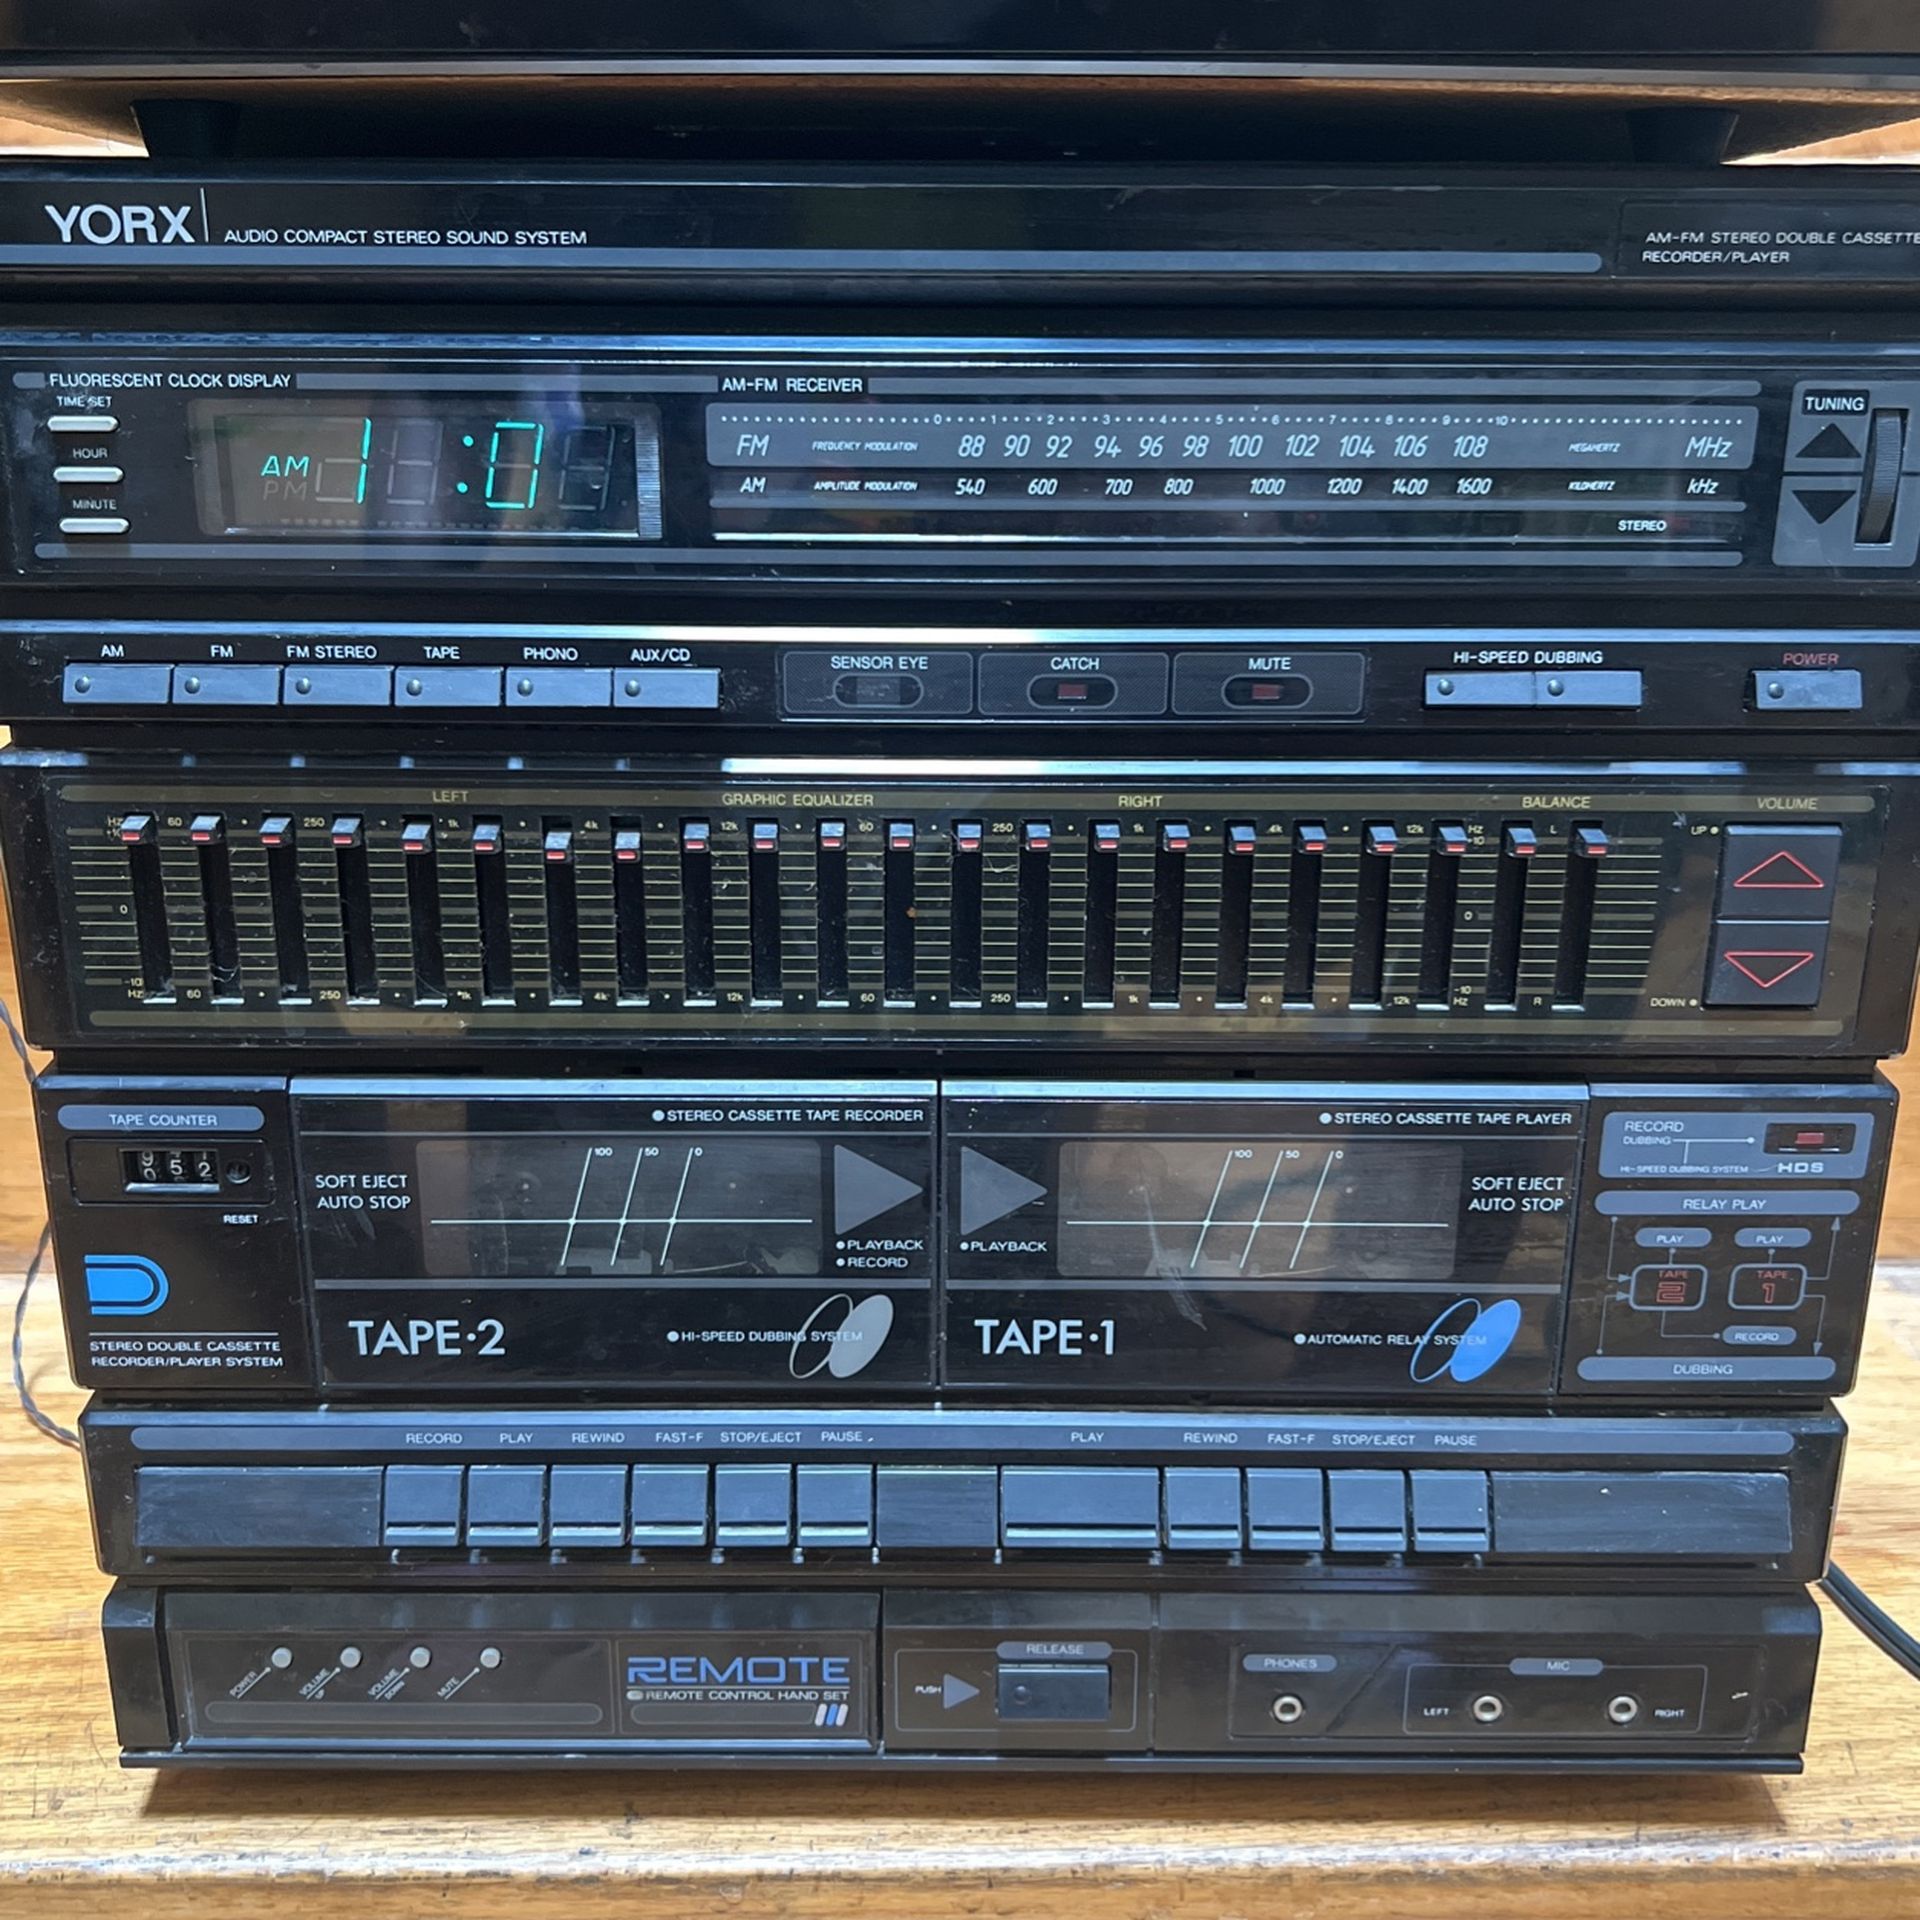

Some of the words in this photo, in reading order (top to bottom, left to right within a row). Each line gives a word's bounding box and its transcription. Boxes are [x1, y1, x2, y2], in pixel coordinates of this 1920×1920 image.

[45, 205, 194, 243] YORX
[224, 229, 278, 243] AUDIO
[284, 230, 367, 244] COMPACT
[374, 230, 440, 244] STEREO
[446, 230, 509, 244] SOUND
[515, 231, 587, 244] SYSTEM
[1644, 231, 1705, 244] AM-FM
[1711, 232, 1771, 244] STEREO
[1775, 232, 1836, 244] DOUBLE
[1842, 232, 1920, 245] CASSETTE
[1642, 251, 1790, 263] RECORDER/PLAYER
[50, 374, 162, 388] FLUORESCENT
[168, 374, 222, 387] CLOCK
[228, 374, 290, 388] DISPLAY
[722, 379, 778, 391] AM-FM
[786, 378, 863, 392] RECEIVER
[57, 396, 85, 408] TIME
[89, 396, 112, 408] SET
[1804, 397, 1865, 411] TUNING
[736, 434, 769, 456] FM
[811, 440, 862, 452] FREQUENCY
[863, 440, 919, 452] MODULATION
[958, 434, 986, 457] 88
[1003, 434, 1031, 457] 90
[1045, 434, 1072, 457] 92
[1094, 434, 1121, 457] 94
[1138, 434, 1164, 457] 96
[1182, 434, 1210, 457] 98
[1228, 434, 1263, 457] 100
[1285, 434, 1319, 457] 102
[1338, 434, 1375, 457] 104
[1393, 434, 1427, 457] 106
[1453, 434, 1488, 458] 108
[1685, 436, 1732, 458] MHz
[72, 447, 109, 460] HOUR
[261, 456, 310, 477] AM
[740, 476, 766, 494] AM
[812, 480, 863, 492] AMPLITUDE
[863, 480, 919, 492] MODULATION
[955, 478, 985, 496] 540
[1028, 478, 1057, 496] 600
[1105, 478, 1132, 496] 700
[1163, 478, 1193, 496] 800
[1250, 478, 1285, 495] 1000
[1327, 478, 1362, 495] 1200
[1392, 478, 1428, 495] 1400
[1456, 478, 1492, 495] 1600
[1687, 478, 1718, 494] kHz
[72, 499, 118, 511] MINUTE
[1618, 519, 1667, 532] STEREO
[101, 646, 124, 658] AM
[211, 646, 233, 659] FM
[287, 646, 310, 659] FM
[314, 646, 377, 659] STEREO
[424, 646, 460, 659] TAPE
[524, 647, 578, 661] PHONO
[630, 647, 691, 662] AUX/CD
[1454, 651, 1528, 664] HI-SPEED
[1534, 651, 1602, 664] DUBBING
[830, 656, 893, 669] SENSOR
[898, 656, 928, 669] EYE
[1051, 657, 1099, 670] CATCH
[1248, 657, 1291, 670] MUTE
[1783, 653, 1839, 665] POWER
[432, 790, 469, 803] LEFT
[722, 794, 786, 806] GRAPHIC
[793, 794, 874, 806] EQUALIZER
[1117, 795, 1163, 808] RIGHT
[1521, 796, 1591, 809] BALANCE
[1756, 797, 1819, 810] VOLUME
[1690, 825, 1708, 836] UP
[1649, 997, 1686, 1008] DOWN
[108, 1113, 144, 1126] TAPE
[149, 1114, 217, 1126] COUNTER
[666, 1109, 724, 1122] STEREO
[727, 1109, 802, 1122] CASSETTE
[805, 1109, 841, 1122] TAPE
[844, 1109, 924, 1122] RECORDER
[1333, 1112, 1393, 1125] STEREO
[1395, 1112, 1472, 1125] CASSETTE
[1476, 1112, 1511, 1125] TAPE
[1515, 1112, 1573, 1125] PLAYER
[1623, 1120, 1685, 1133] RECORD
[1622, 1135, 1672, 1146] DUBBING
[1777, 1161, 1825, 1174] HDS
[315, 1175, 356, 1188] SOFT
[362, 1175, 408, 1189] EJECT
[1472, 1177, 1513, 1191] SOFT
[1518, 1177, 1564, 1191] EJECT
[317, 1196, 364, 1209] AUTO
[369, 1196, 411, 1209] STOP
[1468, 1198, 1515, 1211] AUTO
[1521, 1198, 1564, 1211] STOP
[1682, 1198, 1728, 1211] RELAY
[1731, 1198, 1767, 1211] PLAY
[222, 1214, 260, 1225] RESET
[846, 1239, 924, 1251] PLAYBACK
[1655, 1234, 1685, 1244] PLAY
[1755, 1234, 1784, 1244] PLAY
[969, 1240, 1048, 1252] PLAYBACK
[846, 1257, 909, 1269] RECORD
[1658, 1269, 1689, 1280] TAPE
[1756, 1269, 1789, 1280] TAPE
[680, 1331, 746, 1343] HI-SPEED
[748, 1331, 807, 1343] DUBBING
[810, 1331, 864, 1343] SYSTEM
[1306, 1333, 1382, 1346] AUTOMATIC
[1386, 1333, 1431, 1346] RELAY
[1432, 1333, 1488, 1346] SYSTEM
[1734, 1331, 1780, 1342] RECORD
[89, 1340, 144, 1352] STEREO
[146, 1340, 203, 1352] DOUBLE
[206, 1340, 281, 1352] CASSETTE
[90, 1356, 222, 1367] RECORDER/PLAYER
[225, 1356, 284, 1367] SYSTEM
[1672, 1363, 1734, 1375] DUBBING
[404, 1432, 464, 1444] RECORD
[499, 1432, 534, 1444] PLAY
[571, 1432, 626, 1444] REWIND
[655, 1431, 704, 1444] FAST-F
[719, 1431, 802, 1444] STOP/EJECT
[820, 1431, 863, 1443] PAUSE
[1070, 1431, 1105, 1444] PLAY
[1182, 1432, 1239, 1444] REWIND
[1267, 1432, 1316, 1445] FAST-F
[1331, 1433, 1416, 1446] STOP/EJECT
[1433, 1434, 1479, 1446] PAUSE
[1025, 1644, 1085, 1655] RELEASE
[627, 1657, 850, 1683] REMOTE
[1263, 1657, 1319, 1670] PHONES
[1545, 1660, 1572, 1672] MIC
[645, 1690, 704, 1701] REMOTE
[707, 1690, 775, 1701] CONTROL
[777, 1690, 819, 1701] HAND
[822, 1690, 850, 1701] SET
[914, 1685, 942, 1694] PUSH
[1422, 1707, 1450, 1717] LEFT
[1654, 1708, 1686, 1719] RIGHT
